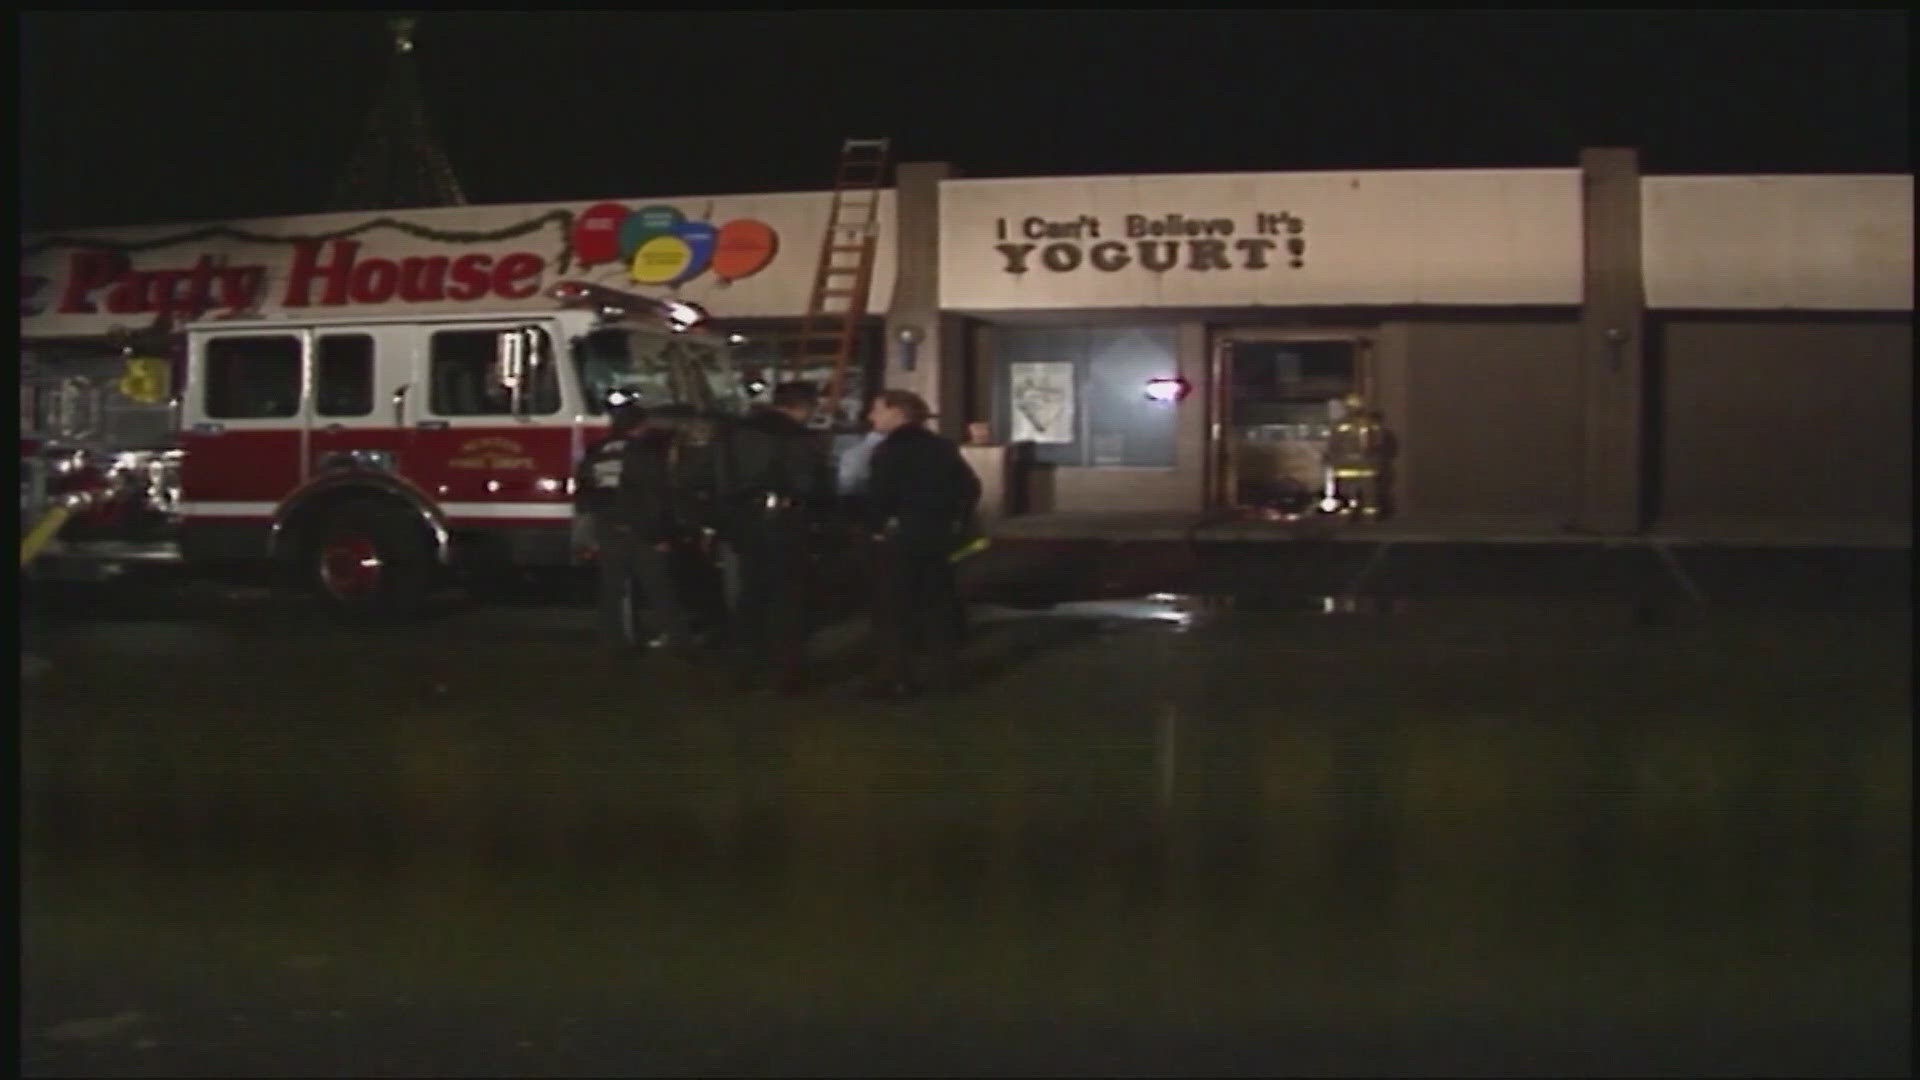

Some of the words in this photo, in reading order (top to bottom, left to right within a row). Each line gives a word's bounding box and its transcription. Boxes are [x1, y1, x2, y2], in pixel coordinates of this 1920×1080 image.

[996, 217, 1007, 240] I
[1023, 214, 1100, 239] Can't
[1126, 213, 1234, 239] Believe
[1256, 211, 1304, 235] It's
[994, 238, 1305, 274] YOGURT!
[56, 251, 268, 320] Party
[281, 238, 546, 307] House
